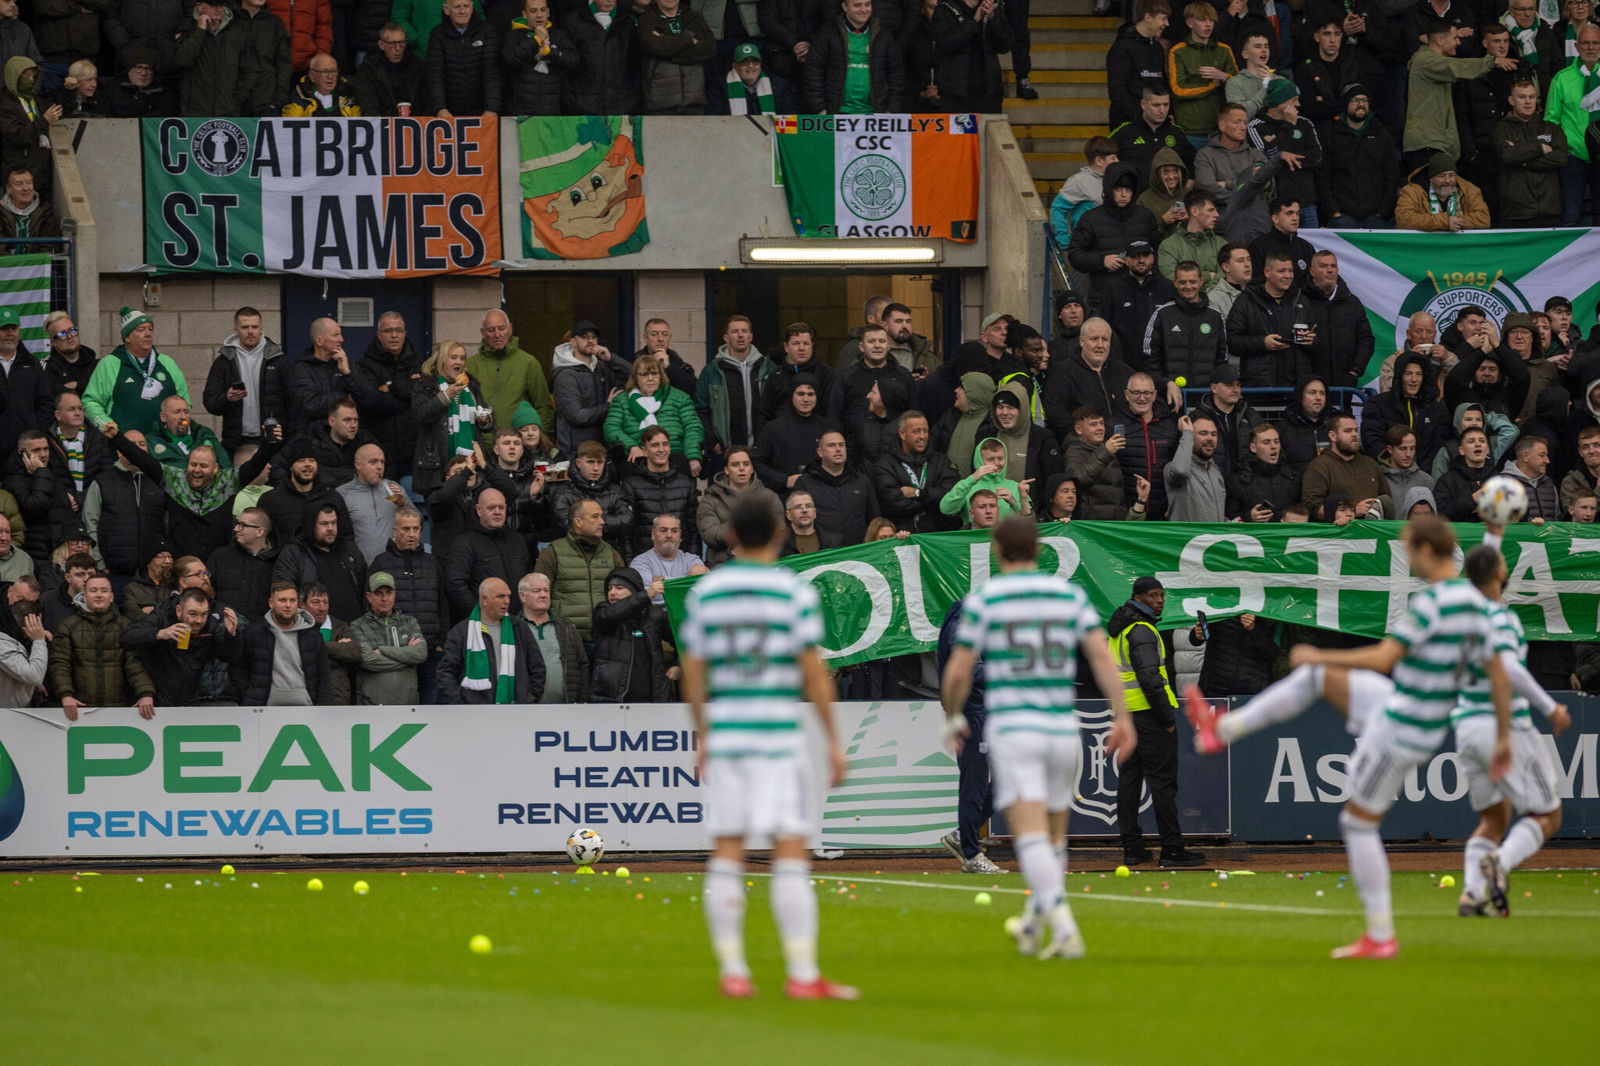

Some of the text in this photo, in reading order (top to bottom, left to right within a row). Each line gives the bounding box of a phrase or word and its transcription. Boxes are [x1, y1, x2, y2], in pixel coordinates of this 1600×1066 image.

[196, 123, 213, 139] CELTIC
[214, 121, 241, 138] FOOTBALL
[801, 118, 945, 133] DICEY REILLY'S
[855, 135, 892, 151] CSC
[162, 192, 486, 271] ST. JAMES
[818, 225, 932, 238] GLASGOW
[1442, 271, 1488, 288] 1945
[1437, 291, 1504, 317] SUPPORTERS
[1004, 619, 1068, 672] 56
[535, 730, 699, 753] PLUMBI
[67, 723, 434, 795] PEAK
[554, 766, 700, 789] HEATIN
[68, 808, 434, 839] RENEWABLES
[498, 802, 705, 825] RENEWAB
